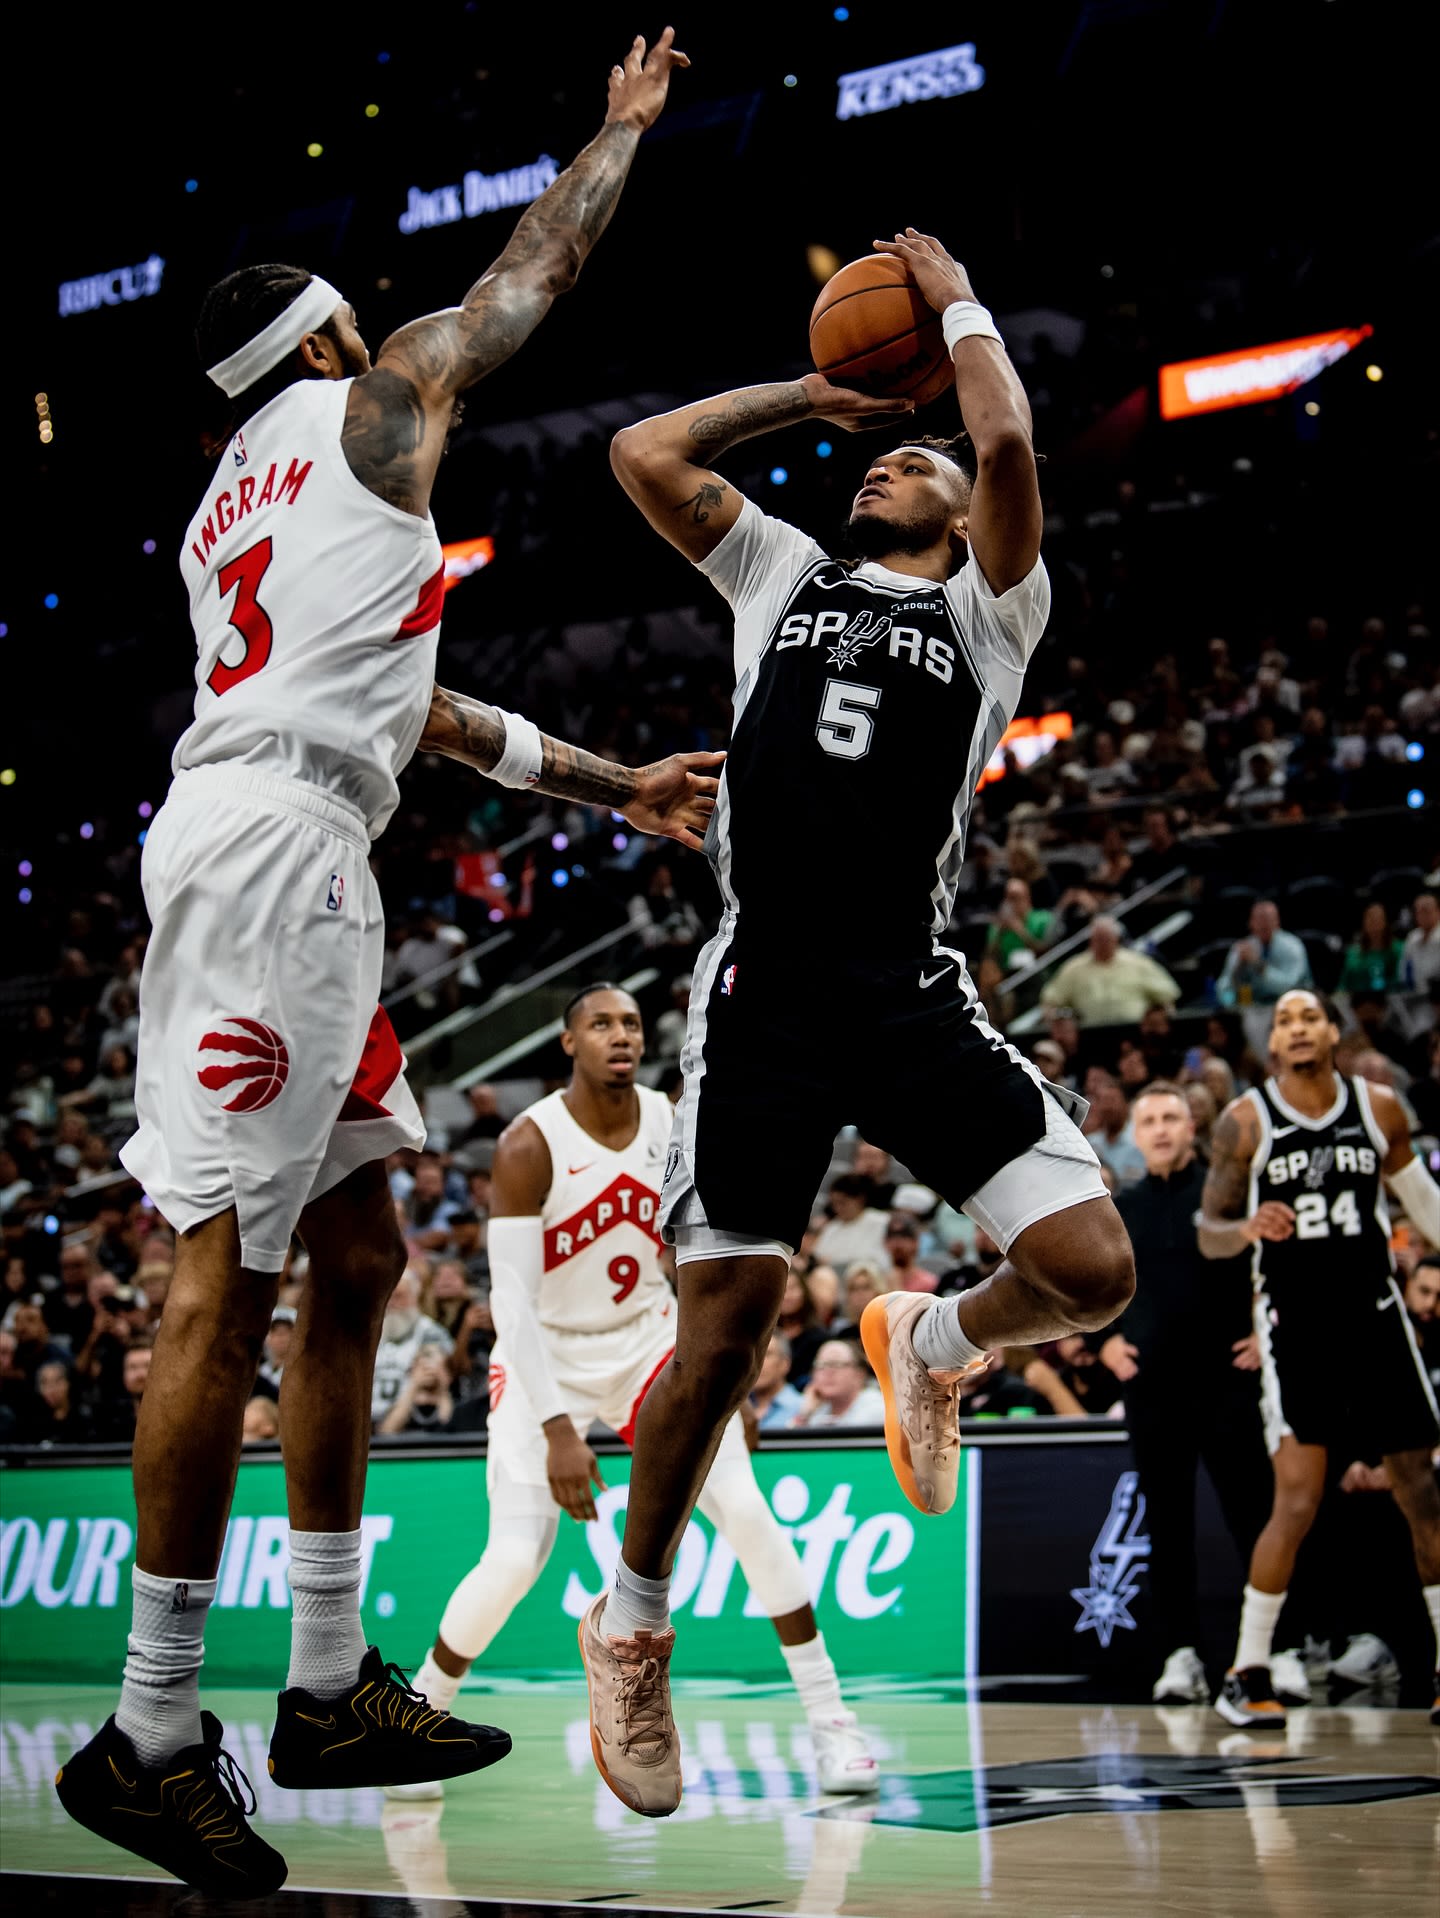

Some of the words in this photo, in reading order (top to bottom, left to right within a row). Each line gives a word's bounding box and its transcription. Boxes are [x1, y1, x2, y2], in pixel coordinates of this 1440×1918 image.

[192, 458, 313, 568] INGRAM
[206, 535, 273, 697] 3
[897, 602, 936, 611] LEDGER
[776, 611, 955, 684] SPURS
[815, 677, 883, 761] 5
[1267, 1145, 1376, 1186] SPURS
[1294, 1190, 1362, 1239] 24
[607, 1255, 640, 1306] 9
[0, 1517, 133, 1608] OUR
